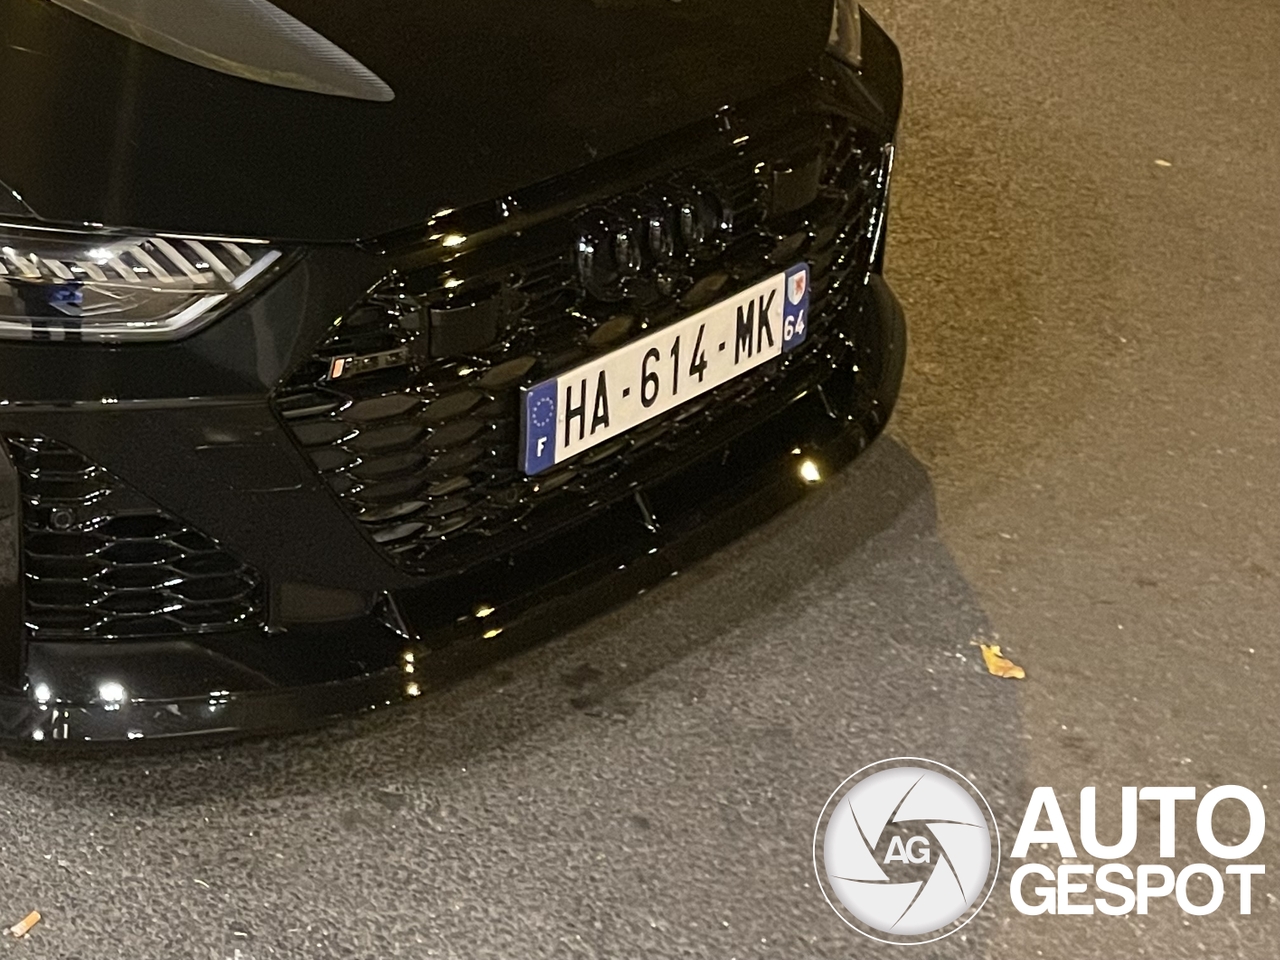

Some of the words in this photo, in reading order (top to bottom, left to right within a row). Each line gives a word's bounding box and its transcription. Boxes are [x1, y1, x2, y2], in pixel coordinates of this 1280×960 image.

[784, 309, 805, 341] 64
[564, 289, 777, 448] HA-614-MK
[537, 436, 547, 457] F
